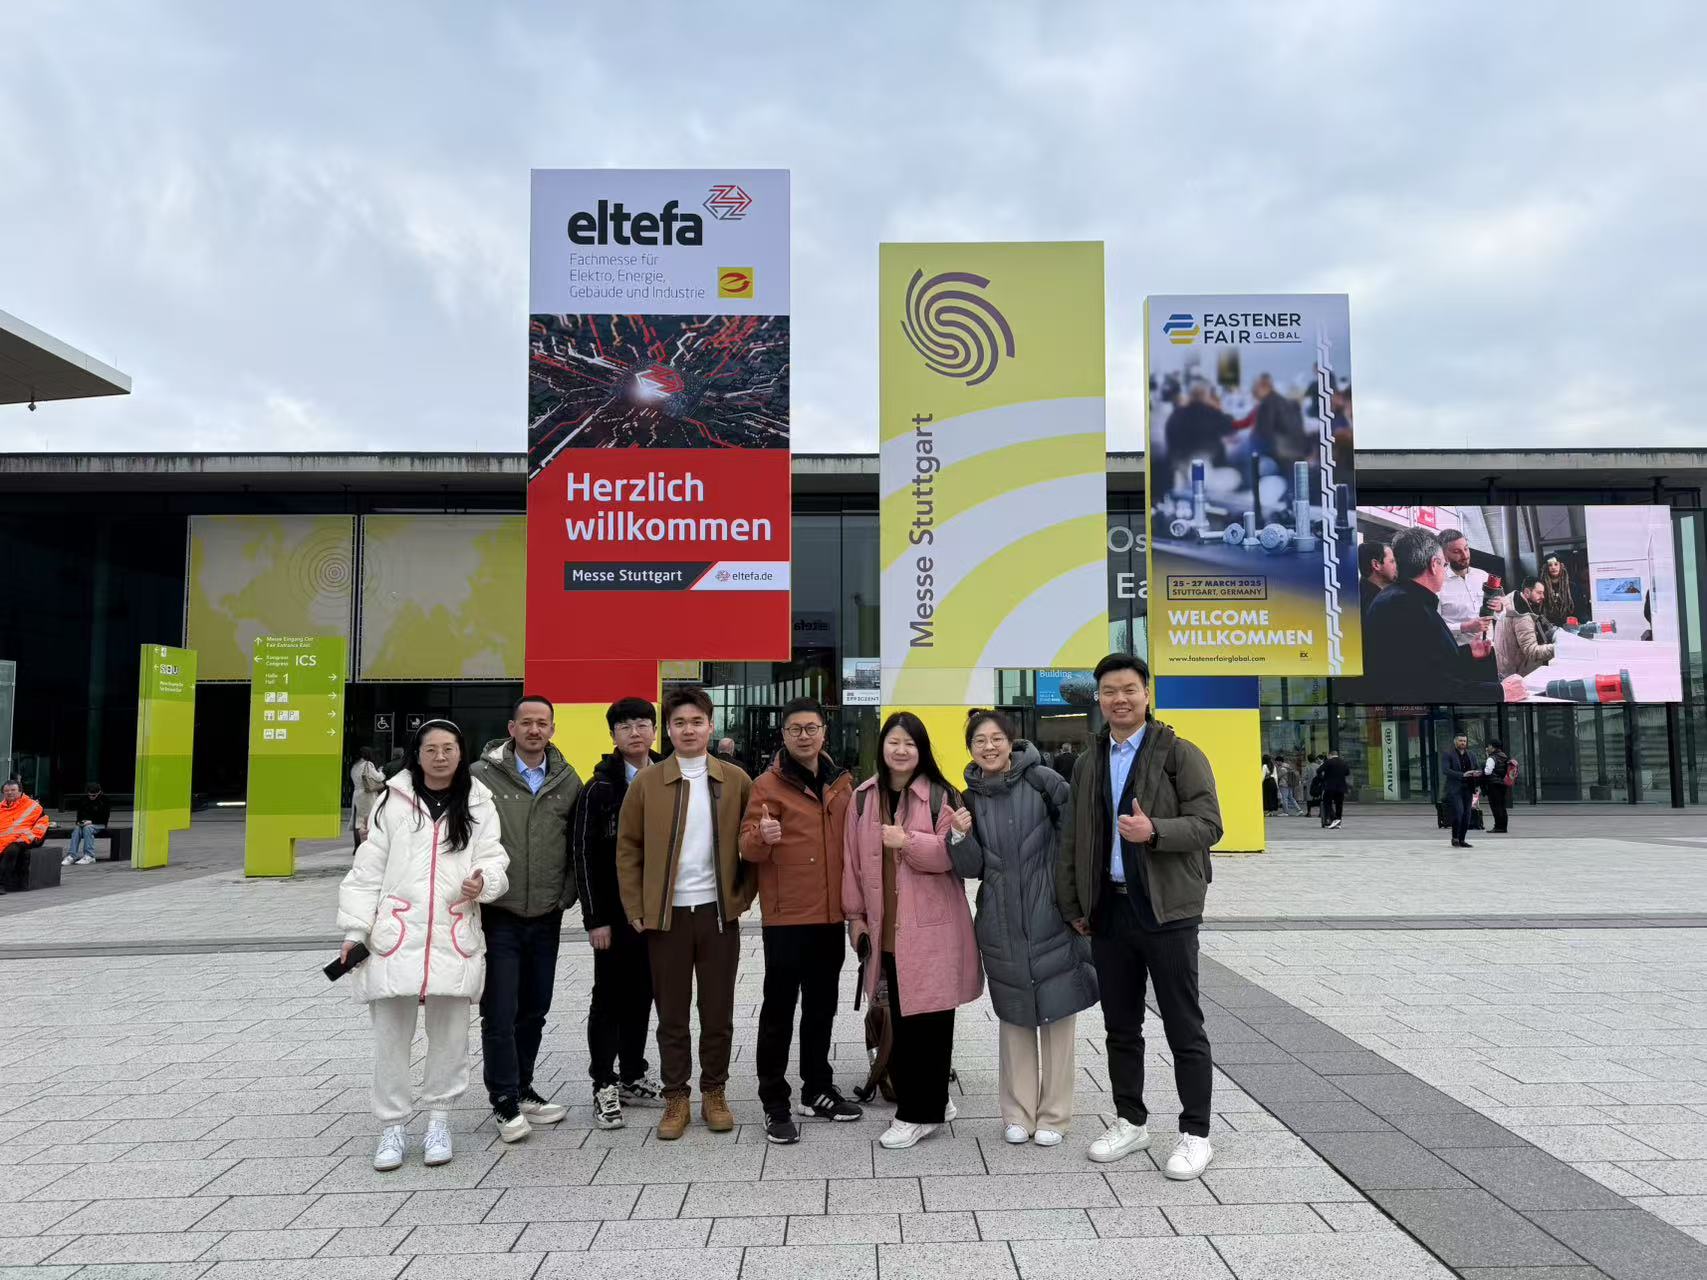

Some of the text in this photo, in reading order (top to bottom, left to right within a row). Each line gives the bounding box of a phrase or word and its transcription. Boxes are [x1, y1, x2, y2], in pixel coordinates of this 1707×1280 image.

[567, 200, 703, 246] eltefa
[570, 253, 659, 265] Fachmesse für
[570, 269, 666, 285] Elektro, Energie,
[569, 285, 705, 299] Gebäude und Industrie
[1204, 313, 1301, 327] FASTENER
[1204, 330, 1300, 343] FAIR GLOBAL
[566, 472, 704, 501] Herzlich
[565, 511, 771, 541] willkommen
[909, 413, 940, 648] Messe Stuttgart
[572, 569, 682, 583] Messe Stuttgart
[732, 570, 773, 581] eltefa.de
[1168, 610, 1269, 626] WELCOME
[1169, 629, 1313, 645] WILLKOMMEN
[295, 655, 317, 666] ICS
[283, 673, 289, 685] 1
[1040, 669, 1073, 679] Building
